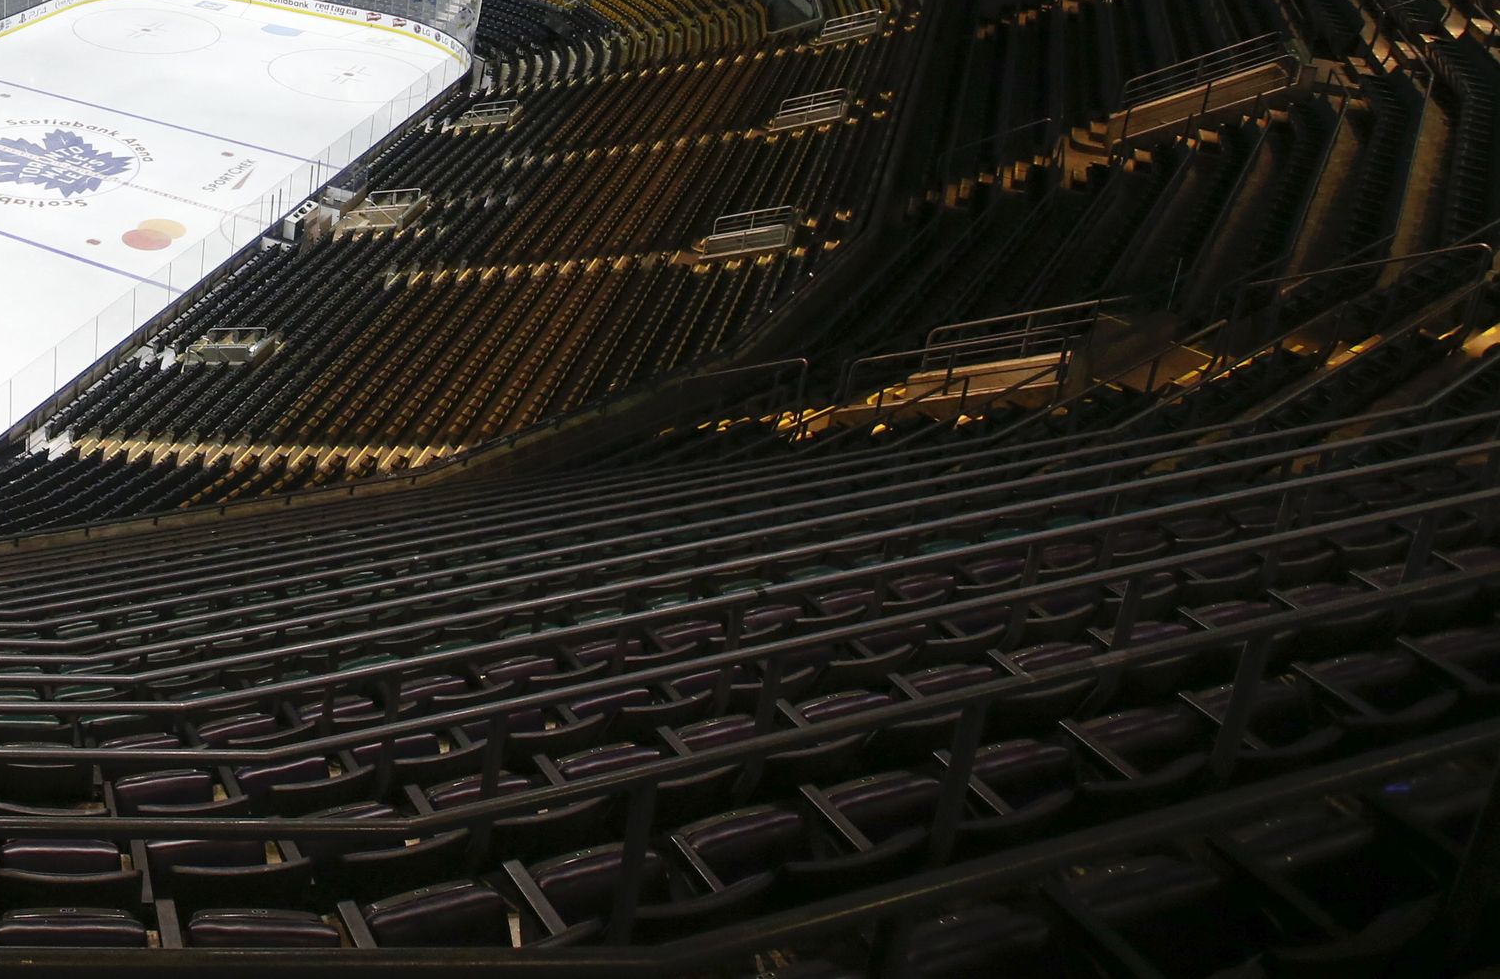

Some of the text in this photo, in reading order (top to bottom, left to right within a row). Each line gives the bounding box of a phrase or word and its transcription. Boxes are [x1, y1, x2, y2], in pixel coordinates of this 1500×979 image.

[422, 29, 431, 37] LG
[6, 118, 155, 163] Scotiabank Arena
[18, 145, 85, 179] TORONTO
